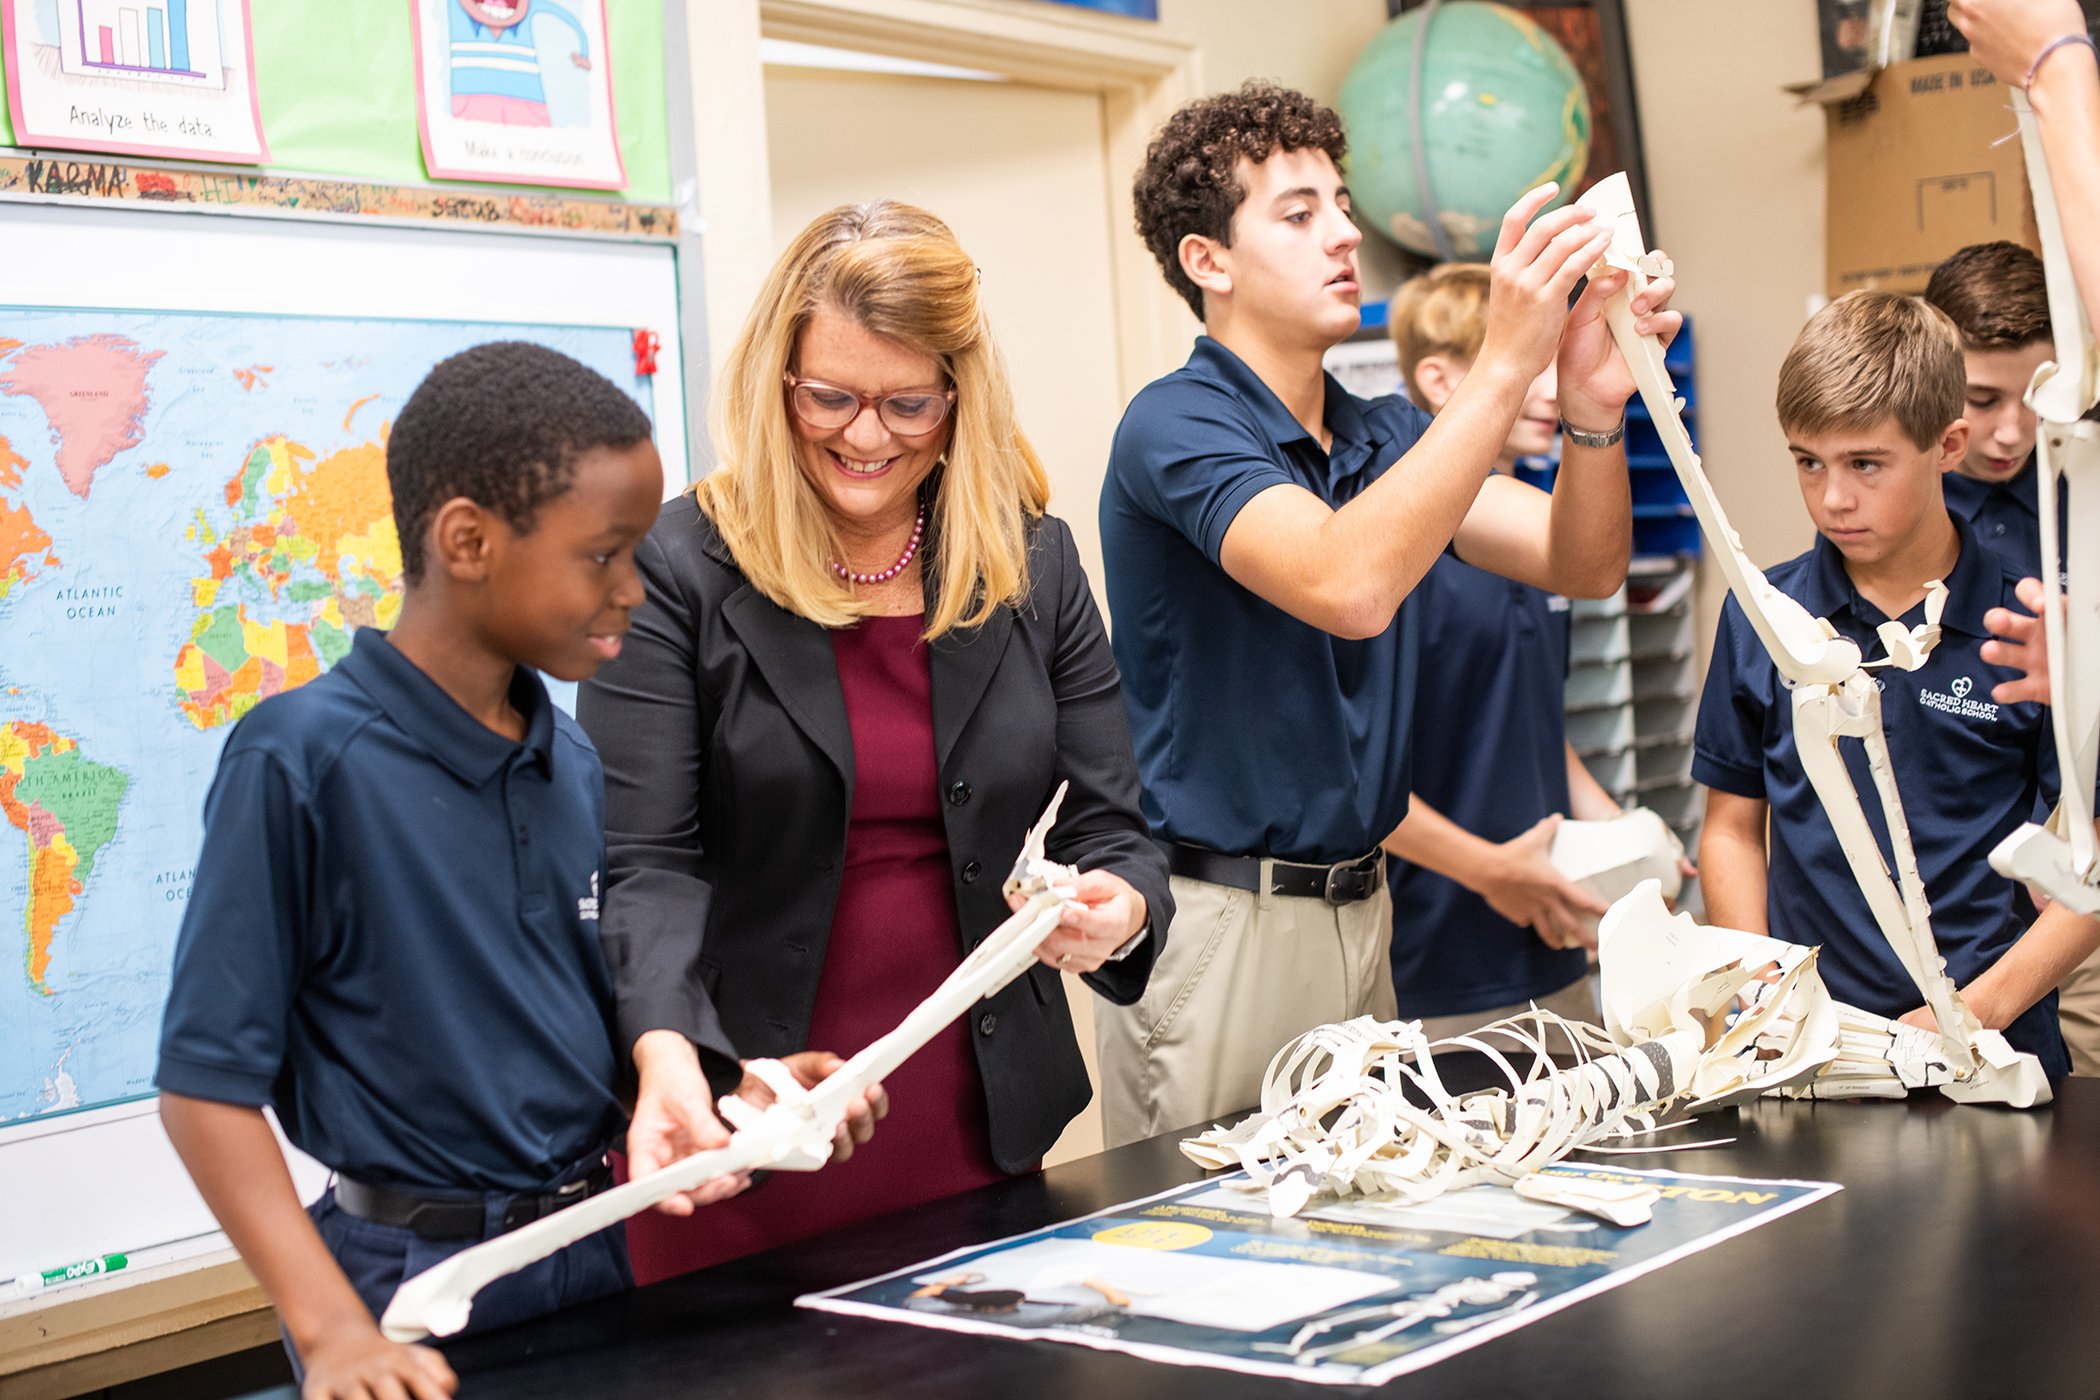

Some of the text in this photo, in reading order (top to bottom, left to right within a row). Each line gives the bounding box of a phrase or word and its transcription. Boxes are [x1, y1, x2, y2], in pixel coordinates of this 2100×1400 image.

[1911, 67, 1998, 94] MADE IN USA
[70, 105, 132, 135] Analyze
[143, 112, 168, 132] the
[56, 586, 124, 601] ATLANTIC
[66, 606, 117, 621] OCEAN
[1919, 697, 1998, 722] CATHOLIC SCHOOL
[1920, 688, 2000, 714] SACRED HEART
[156, 868, 196, 885] ATLAN
[166, 886, 192, 902] OCE
